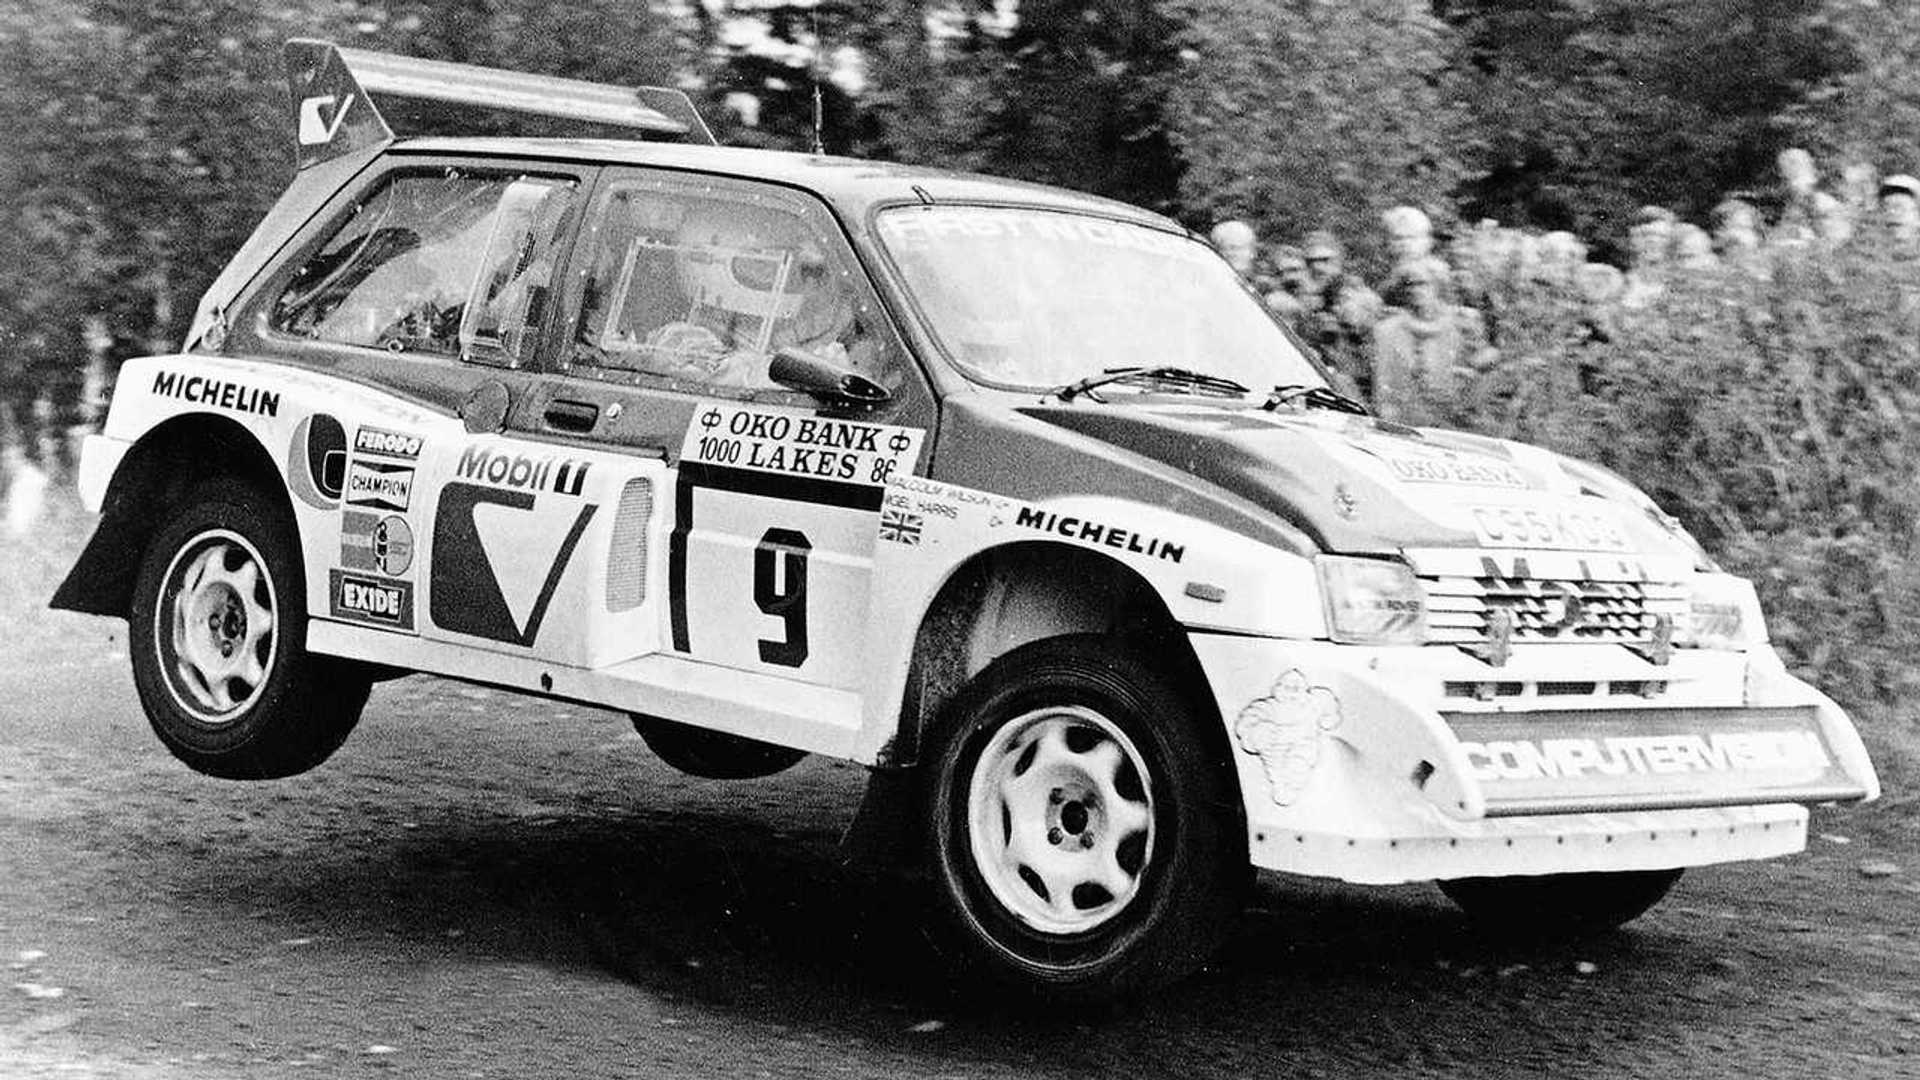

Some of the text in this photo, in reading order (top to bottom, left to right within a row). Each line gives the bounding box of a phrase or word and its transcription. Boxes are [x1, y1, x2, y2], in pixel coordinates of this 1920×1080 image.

[152, 371, 280, 417] MICHELIN
[356, 430, 420, 454] FERODO
[730, 411, 883, 451] OKO BANK
[456, 444, 552, 490] Mobil
[699, 437, 741, 464] 1000
[747, 443, 858, 479] LAKES
[352, 475, 408, 496] CHAMPION
[1016, 507, 1185, 563] MICHELIN
[343, 582, 399, 615] EXIDE
[754, 527, 812, 667] 9
